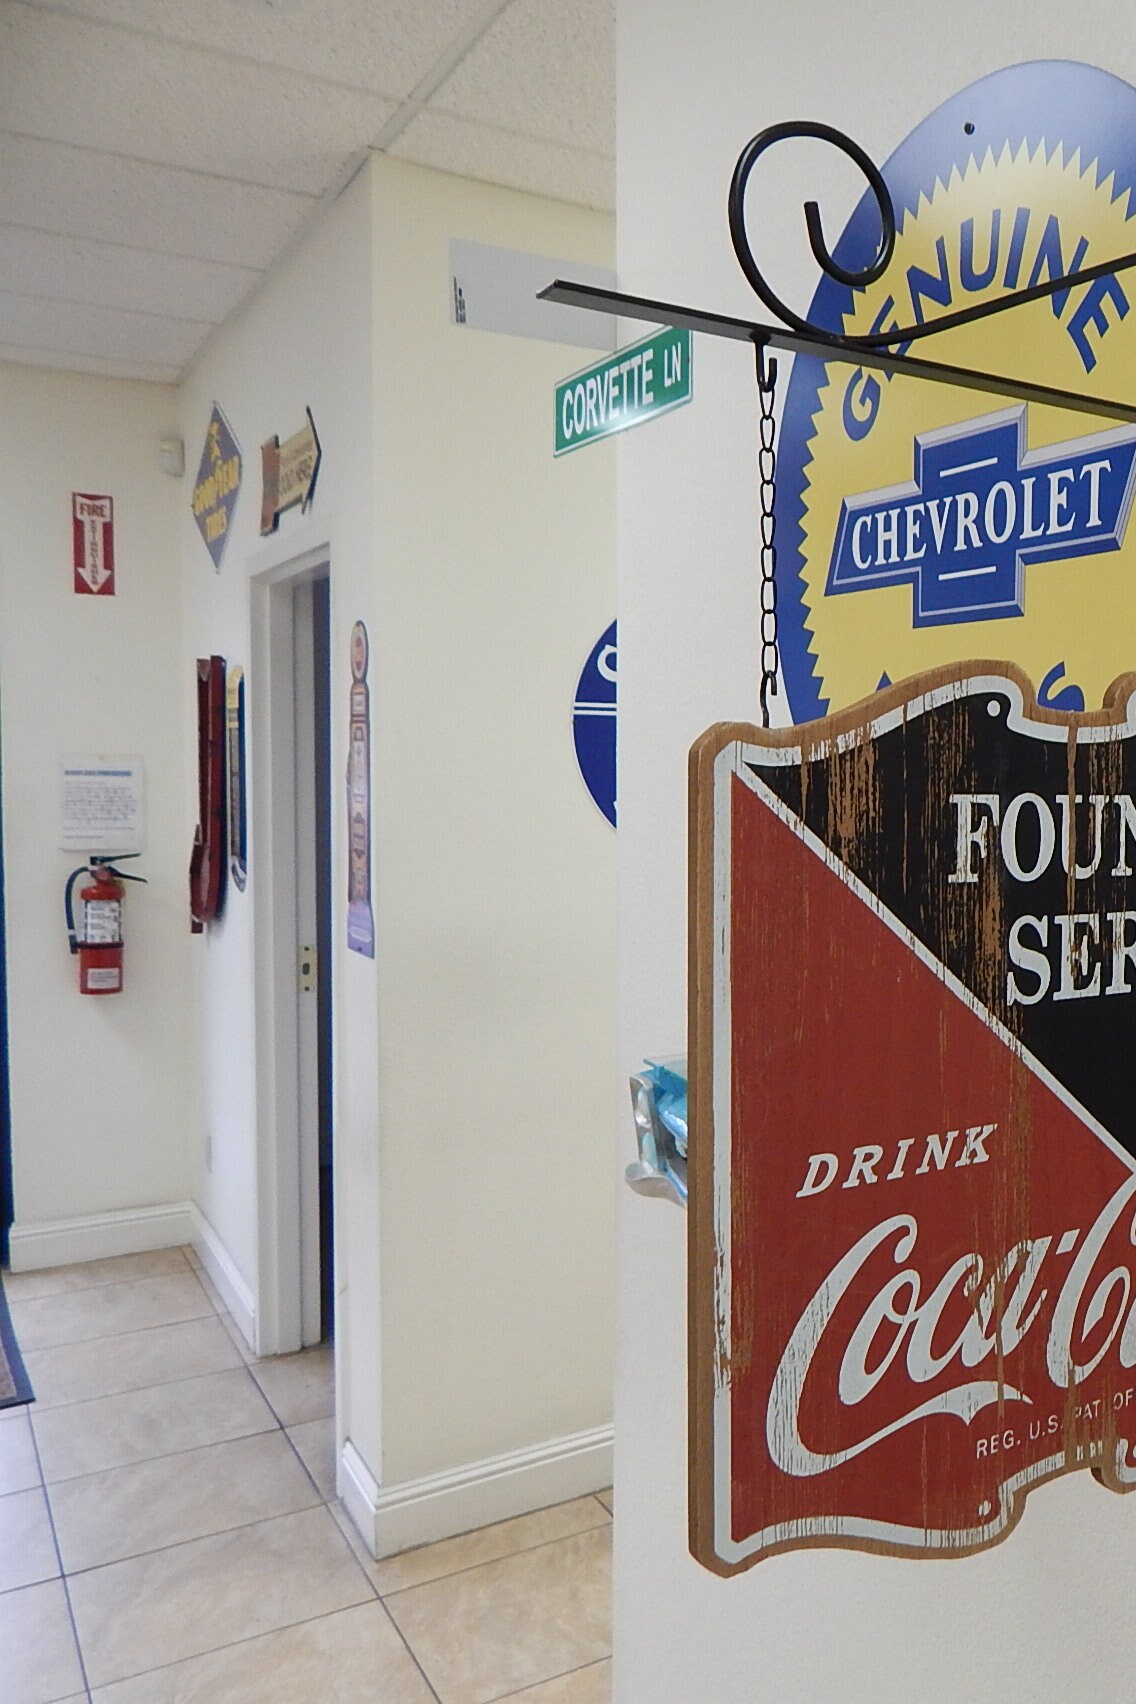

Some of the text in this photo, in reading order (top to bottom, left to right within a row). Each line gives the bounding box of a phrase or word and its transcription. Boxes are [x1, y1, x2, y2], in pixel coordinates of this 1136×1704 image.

[562, 342, 681, 439] CORVETTE LN
[79, 502, 107, 517] FIRE
[851, 459, 1112, 569] CHEVROLET
[796, 1123, 998, 1197] DRINK
[976, 1429, 1021, 1460] REG.
